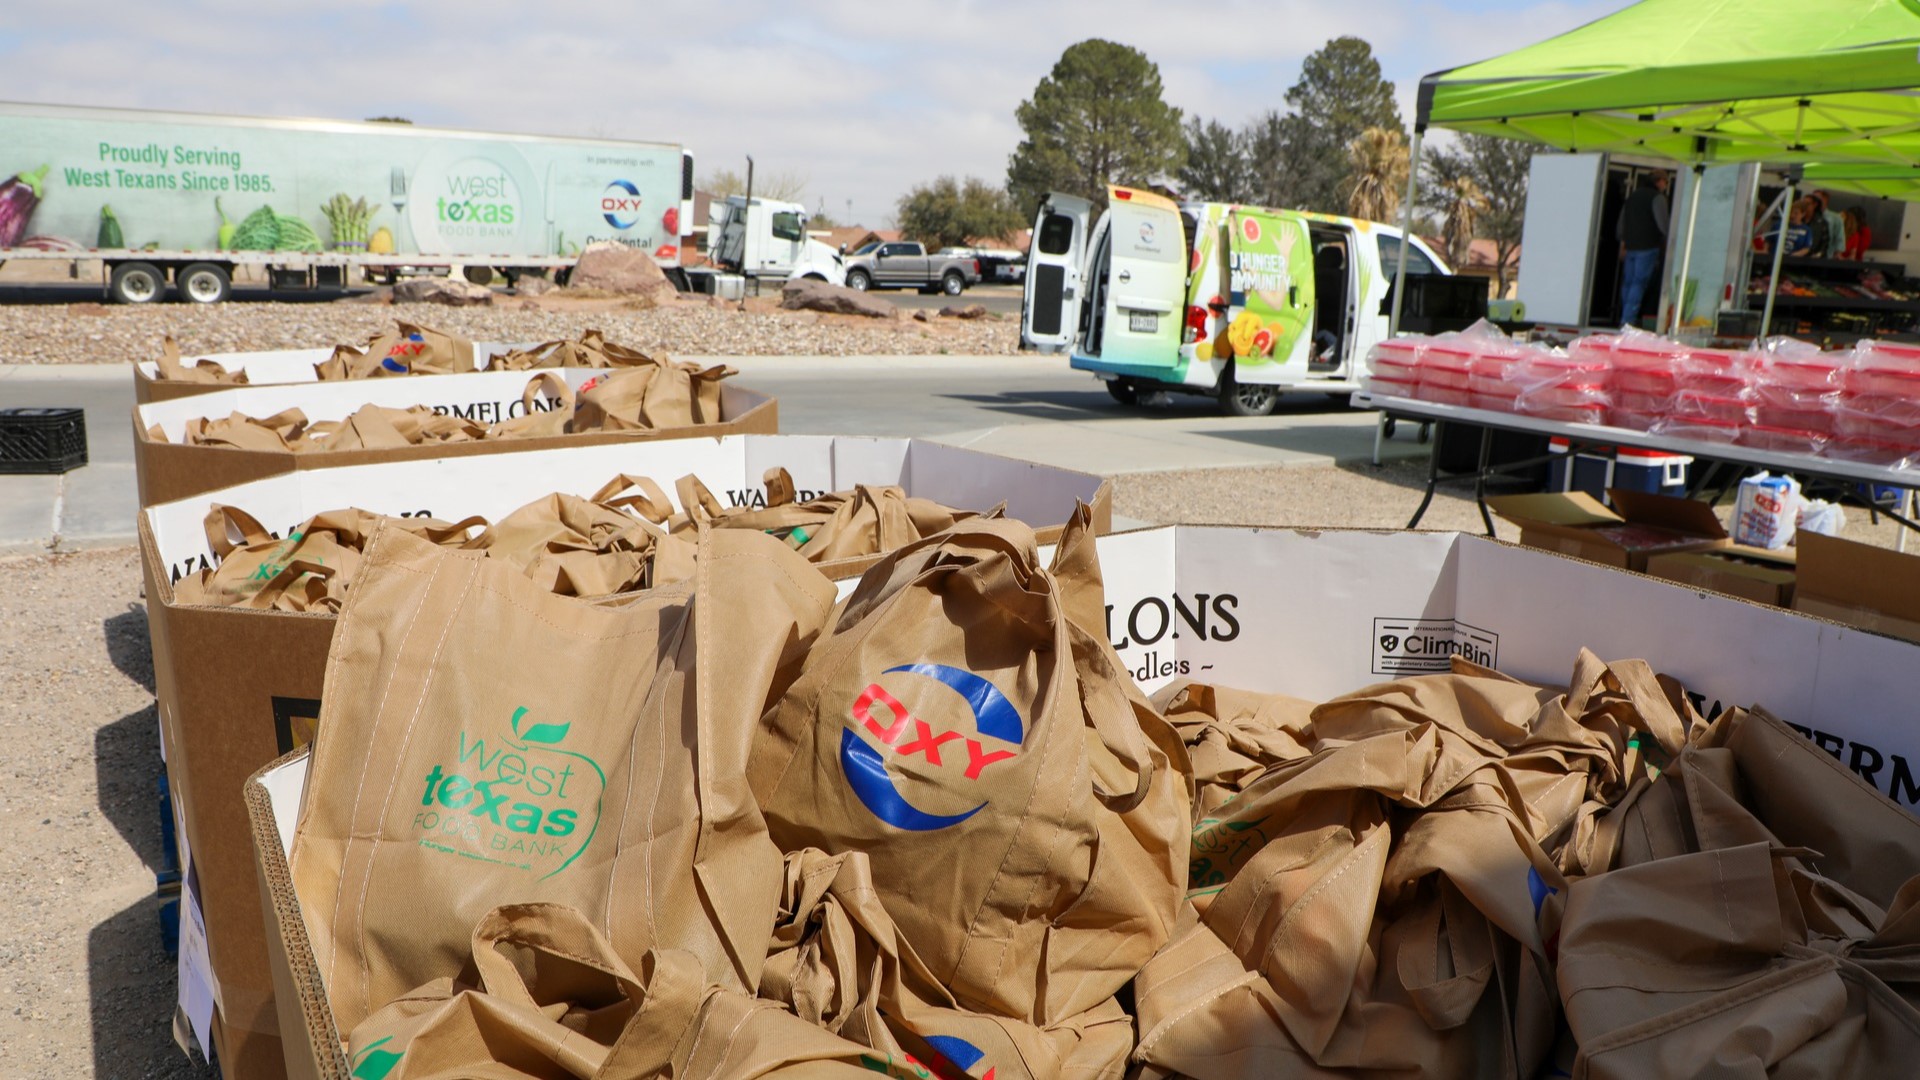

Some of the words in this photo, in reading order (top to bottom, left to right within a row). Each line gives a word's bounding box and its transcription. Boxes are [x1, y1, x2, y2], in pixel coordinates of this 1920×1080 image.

[98, 142, 168, 168] Proudly
[173, 145, 241, 171] Serving
[64, 167, 111, 188] West
[115, 168, 177, 190] Texans
[182, 171, 229, 191] Since
[234, 174, 276, 193] 1985.
[447, 173, 507, 198] west
[436, 196, 514, 224] texas
[601, 198, 642, 211] OXY
[438, 224, 474, 237] FOOD
[479, 225, 513, 238] BANK
[1240, 251, 1286, 274] HUNGER
[1404, 635, 1491, 668] ClimaBin
[851, 682, 1017, 780] OXY
[459, 731, 574, 798] west
[421, 764, 577, 837] texas
[412, 811, 481, 841] FOOD
[491, 832, 567, 857] BANK
